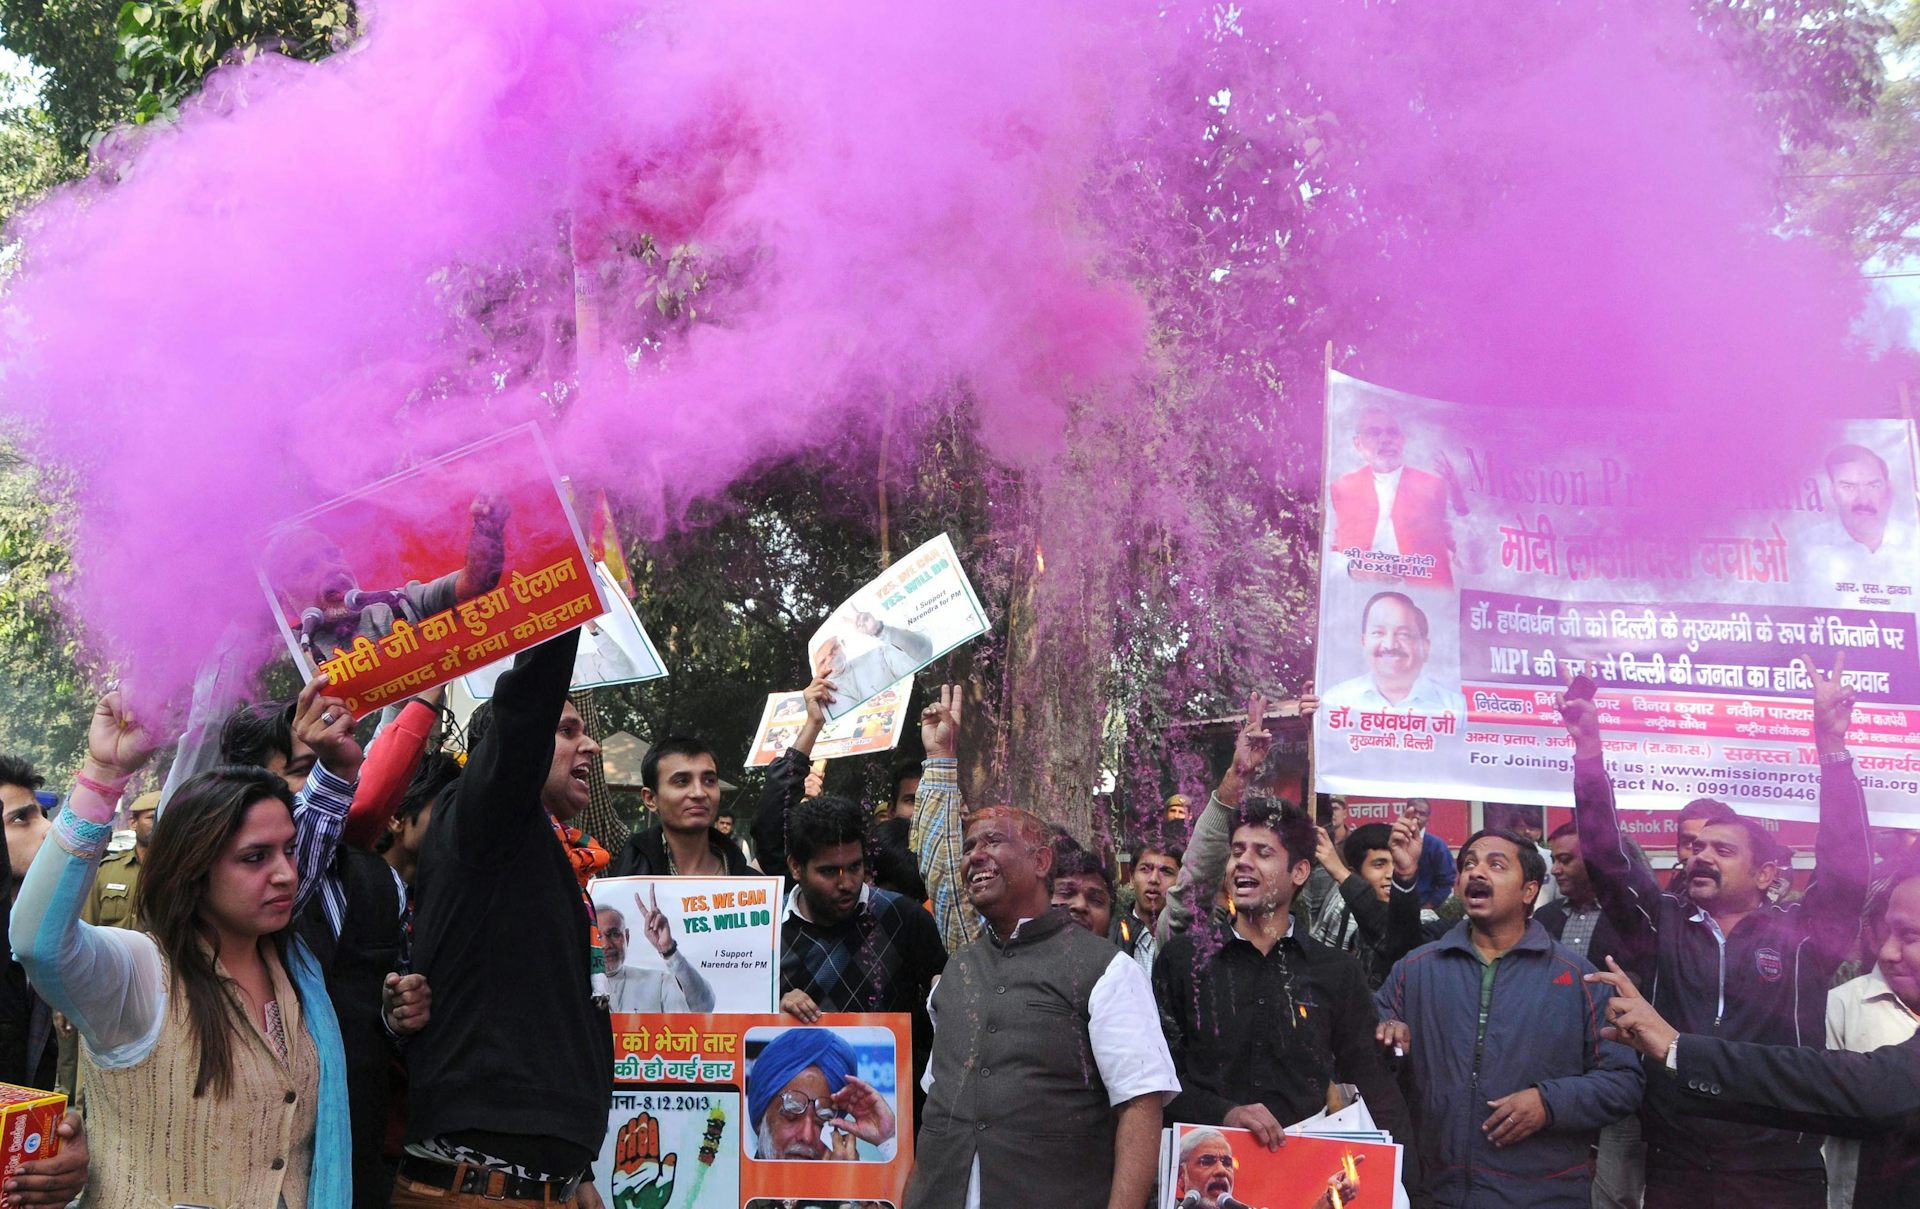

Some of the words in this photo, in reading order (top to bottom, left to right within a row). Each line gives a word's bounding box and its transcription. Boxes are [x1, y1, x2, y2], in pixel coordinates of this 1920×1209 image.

[1344, 548, 1360, 558] श्री
[1405, 555, 1434, 566] मोदी
[1499, 512, 1558, 576] मोदी
[1701, 521, 1788, 582] बचाओ
[904, 570, 933, 593] WILL
[931, 558, 949, 575] DO
[1351, 560, 1392, 572] Next
[907, 605, 938, 625] Narendra
[951, 590, 962, 600] PM
[920, 590, 946, 608] Support
[320, 636, 379, 686] मोदी
[379, 617, 417, 659] जी
[418, 608, 457, 642] का
[457, 587, 510, 636] हुआ
[510, 557, 578, 605] ऐलान
[1470, 601, 1492, 630] डॉ.
[1496, 603, 1555, 636] हर्षवर्धन
[1558, 608, 1580, 637] जी
[1584, 610, 1607, 638] को
[1611, 609, 1657, 640] दिल्ली
[1659, 610, 1678, 639] के
[1681, 612, 1752, 652] मुख्यमंत्री
[1755, 615, 1773, 643] के
[1776, 623, 1805, 645] रूप
[1808, 617, 1826, 645] में
[1827, 616, 1880, 648] जिताने
[1881, 628, 1904, 650] पर
[361, 667, 436, 703] जनपद
[440, 645, 461, 672] में
[463, 632, 508, 662] मचा
[511, 593, 593, 640] कोहराम
[1489, 646, 1530, 675] MPI
[1533, 649, 1557, 677] की
[1599, 653, 1617, 680] से
[1619, 651, 1665, 684] दिल्ली
[1668, 654, 1692, 685] की
[1694, 664, 1744, 688] जनता
[1746, 666, 1770, 689] का
[1827, 669, 1890, 694] न्यवाद
[1474, 692, 1523, 713] निवेदक
[1329, 705, 1354, 729] डॉ.
[1360, 706, 1427, 732] हर्षवर्धन
[1431, 710, 1456, 734] जी
[1403, 733, 1434, 750] दिल्ली
[1466, 732, 1499, 743] अभय
[1545, 735, 1575, 748] अजी
[1600, 740, 1637, 752] रद्वाज
[1723, 747, 1792, 764] समस्त
[1470, 752, 1498, 764] For
[1624, 763, 1644, 773] us
[1611, 776, 1645, 790] tact
[1651, 779, 1680, 792] No.
[1697, 781, 1816, 801] 09910850446
[1348, 803, 1389, 819] जनता
[1620, 820, 1661, 833] Ashok
[682, 894, 710, 912] YES,
[712, 892, 736, 908] WE
[737, 889, 766, 906] CAN
[683, 916, 711, 934] YES,
[714, 912, 748, 929] WILL
[750, 910, 770, 926] DO
[701, 960, 738, 969] Narendra
[741, 960, 752, 969] for
[755, 960, 768, 969] PM
[721, 949, 753, 959] Support
[622, 1026, 650, 1052] को
[655, 1025, 698, 1053] भेजो
[703, 1033, 737, 1053] तार
[614, 1056, 639, 1076] की
[644, 1057, 663, 1078] हो
[668, 1056, 698, 1079] गई
[702, 1063, 733, 1079] हार
